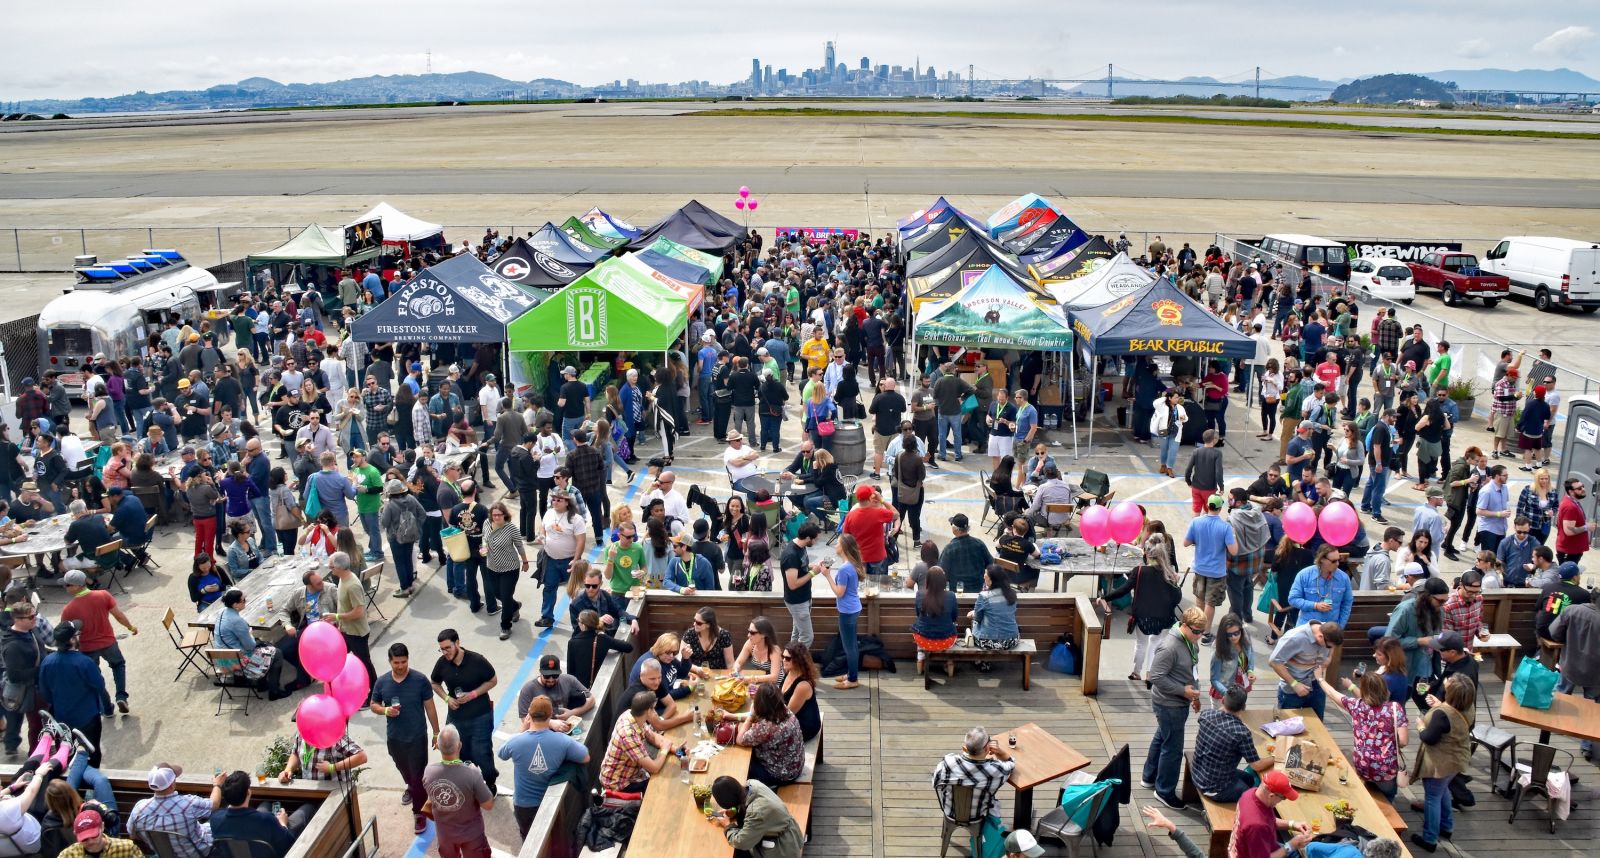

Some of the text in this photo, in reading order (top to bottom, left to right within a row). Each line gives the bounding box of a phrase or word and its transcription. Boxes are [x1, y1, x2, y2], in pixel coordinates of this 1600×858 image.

[398, 278, 455, 316] FIRESTONE
[962, 298, 1028, 310] ANDERSON VALLEY
[1151, 299, 1185, 311] RACER
[579, 296, 595, 340] B
[1161, 308, 1178, 319] 5
[377, 325, 478, 334] FIRESTONE WALKER
[977, 332, 991, 343] that
[1017, 336, 1036, 346] Good
[1129, 339, 1225, 354] BEAR REPUBLIC
